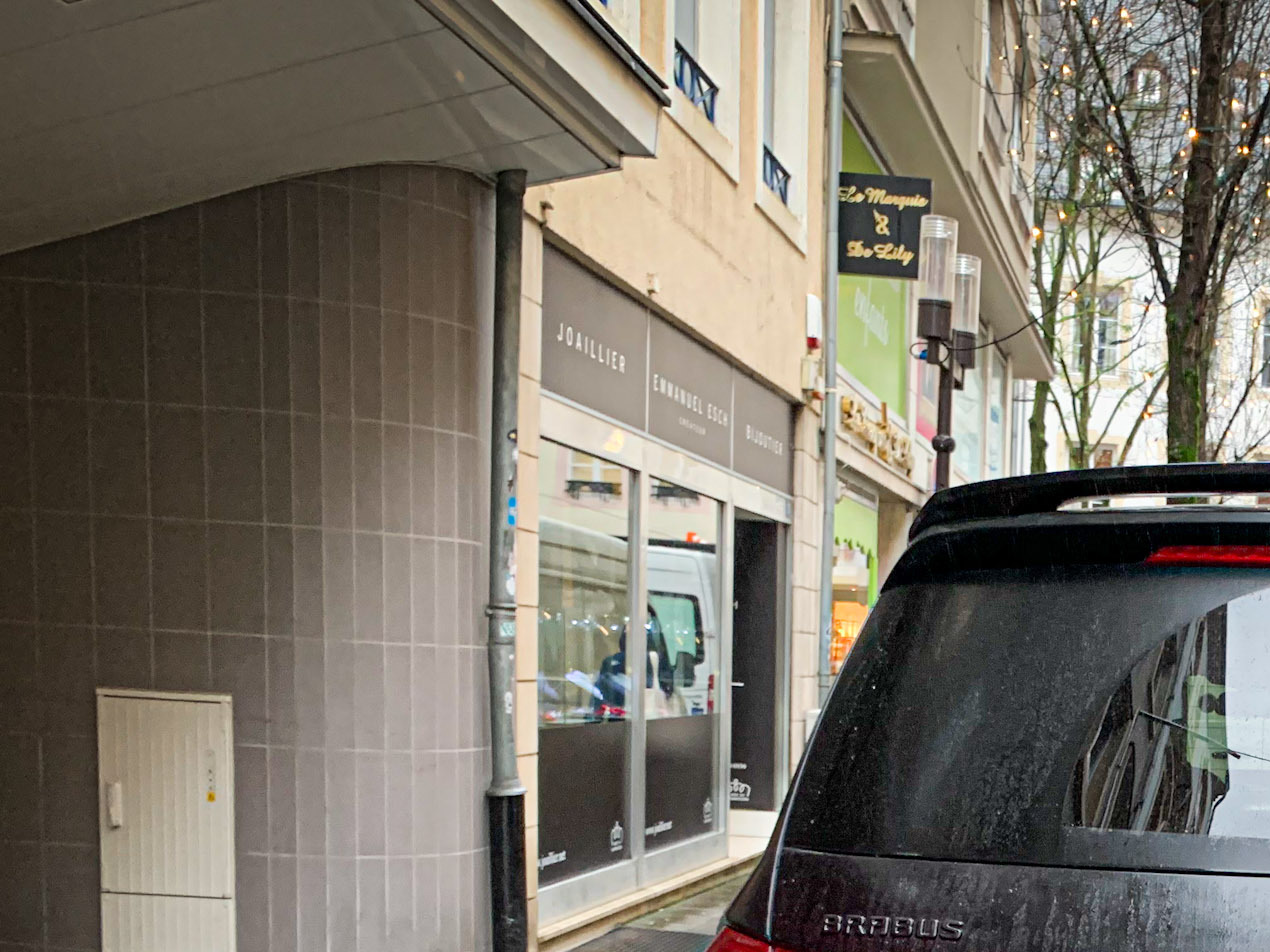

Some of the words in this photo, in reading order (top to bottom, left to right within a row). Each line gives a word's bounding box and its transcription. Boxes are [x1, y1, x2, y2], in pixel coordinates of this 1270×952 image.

[873, 208, 890, 236] &
[873, 242, 915, 266] Lily
[556, 322, 626, 374] JOAILLIER
[652, 373, 704, 416] EMMANUEL
[707, 403, 729, 428] ESCH
[745, 423, 784, 456] BIJOUTIER
[821, 913, 965, 941] BRABUS
